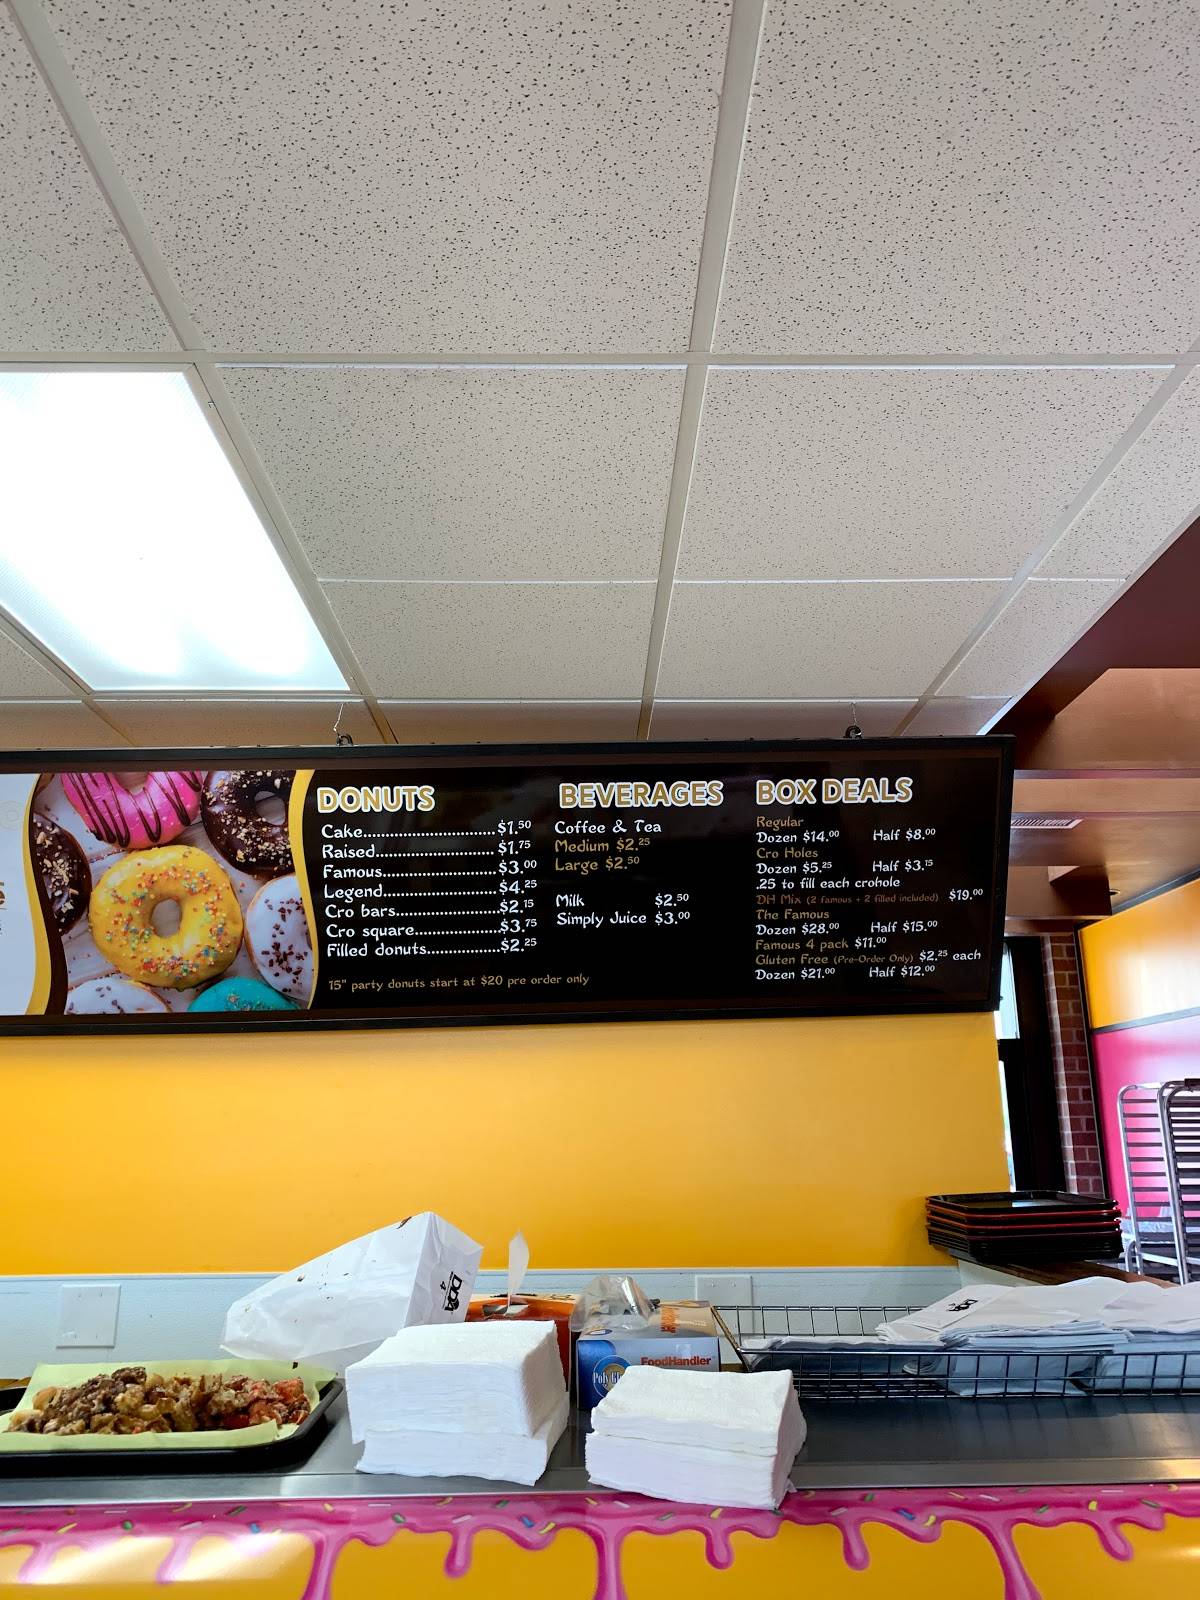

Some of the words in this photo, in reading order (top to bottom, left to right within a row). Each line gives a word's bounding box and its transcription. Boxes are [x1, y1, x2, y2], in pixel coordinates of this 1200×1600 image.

[559, 780, 724, 808] BEVERAGES
[755, 778, 817, 805] BOX
[822, 777, 913, 804] DEALS
[317, 785, 435, 813] DONUTS
[498, 820, 532, 835] $1.50
[555, 820, 605, 834] Coffee
[613, 820, 627, 833] &
[635, 820, 661, 833] Tea
[756, 816, 804, 831] Regular
[756, 832, 797, 843] Dozen
[803, 830, 840, 843] $14.00
[873, 829, 900, 840] Half
[906, 829, 936, 840] $8.00
[498, 839, 531, 855] $1.75
[555, 839, 609, 852] Medium
[617, 838, 650, 853] $2.25
[756, 848, 779, 859] Cro
[784, 847, 818, 858] Holes
[498, 859, 537, 875] $3.00
[555, 858, 598, 875] Large
[605, 856, 640, 871] $2.50
[756, 863, 796, 874] Dozen
[803, 862, 832, 874] $5.25
[872, 860, 898, 871] Half
[499, 879, 537, 895] $4.25
[756, 879, 776, 890] .25
[782, 879, 794, 889] to
[800, 878, 815, 889] fill
[820, 878, 849, 888] each
[855, 876, 900, 888] crohole
[555, 894, 585, 907] Milk
[655, 893, 689, 908] $2.50
[756, 895, 775, 905] DH
[781, 894, 801, 904] Mix
[821, 895, 852, 903] famous
[875, 894, 896, 903] filled
[899, 893, 938, 902] included)
[949, 888, 983, 902] $19.00
[325, 904, 354, 918] Cro
[756, 910, 779, 920] The
[784, 909, 829, 919] Famous
[557, 912, 603, 928] Simply
[610, 911, 646, 924] Juice
[655, 911, 690, 926] $3.00
[326, 924, 355, 938] Cro
[756, 925, 796, 936] Dozen
[801, 923, 840, 936] $28.00
[870, 922, 897, 933] Half
[903, 920, 938, 933] $15.00
[327, 943, 367, 957] Filled
[756, 940, 800, 951] Famous
[805, 939, 815, 949] 4
[820, 939, 848, 952] pack
[855, 937, 887, 949] $11.00
[755, 954, 795, 966] Gluten
[801, 953, 828, 964] Free
[833, 955, 884, 964] (Pre-Order
[890, 954, 914, 964] Only)
[919, 949, 948, 962] $2.25
[952, 949, 981, 961] each
[755, 969, 795, 980] Dozen
[801, 968, 835, 980] $21.00
[869, 966, 895, 978] Half
[900, 965, 935, 977] $12.00
[351, 980, 383, 993] party
[388, 978, 425, 989] donuts
[430, 977, 458, 988] start
[463, 977, 476, 987] at
[481, 975, 503, 987] $20
[507, 977, 526, 989] pre
[531, 975, 564, 985] order
[567, 973, 589, 985] only
[640, 1357, 712, 1366] FoodHandler
